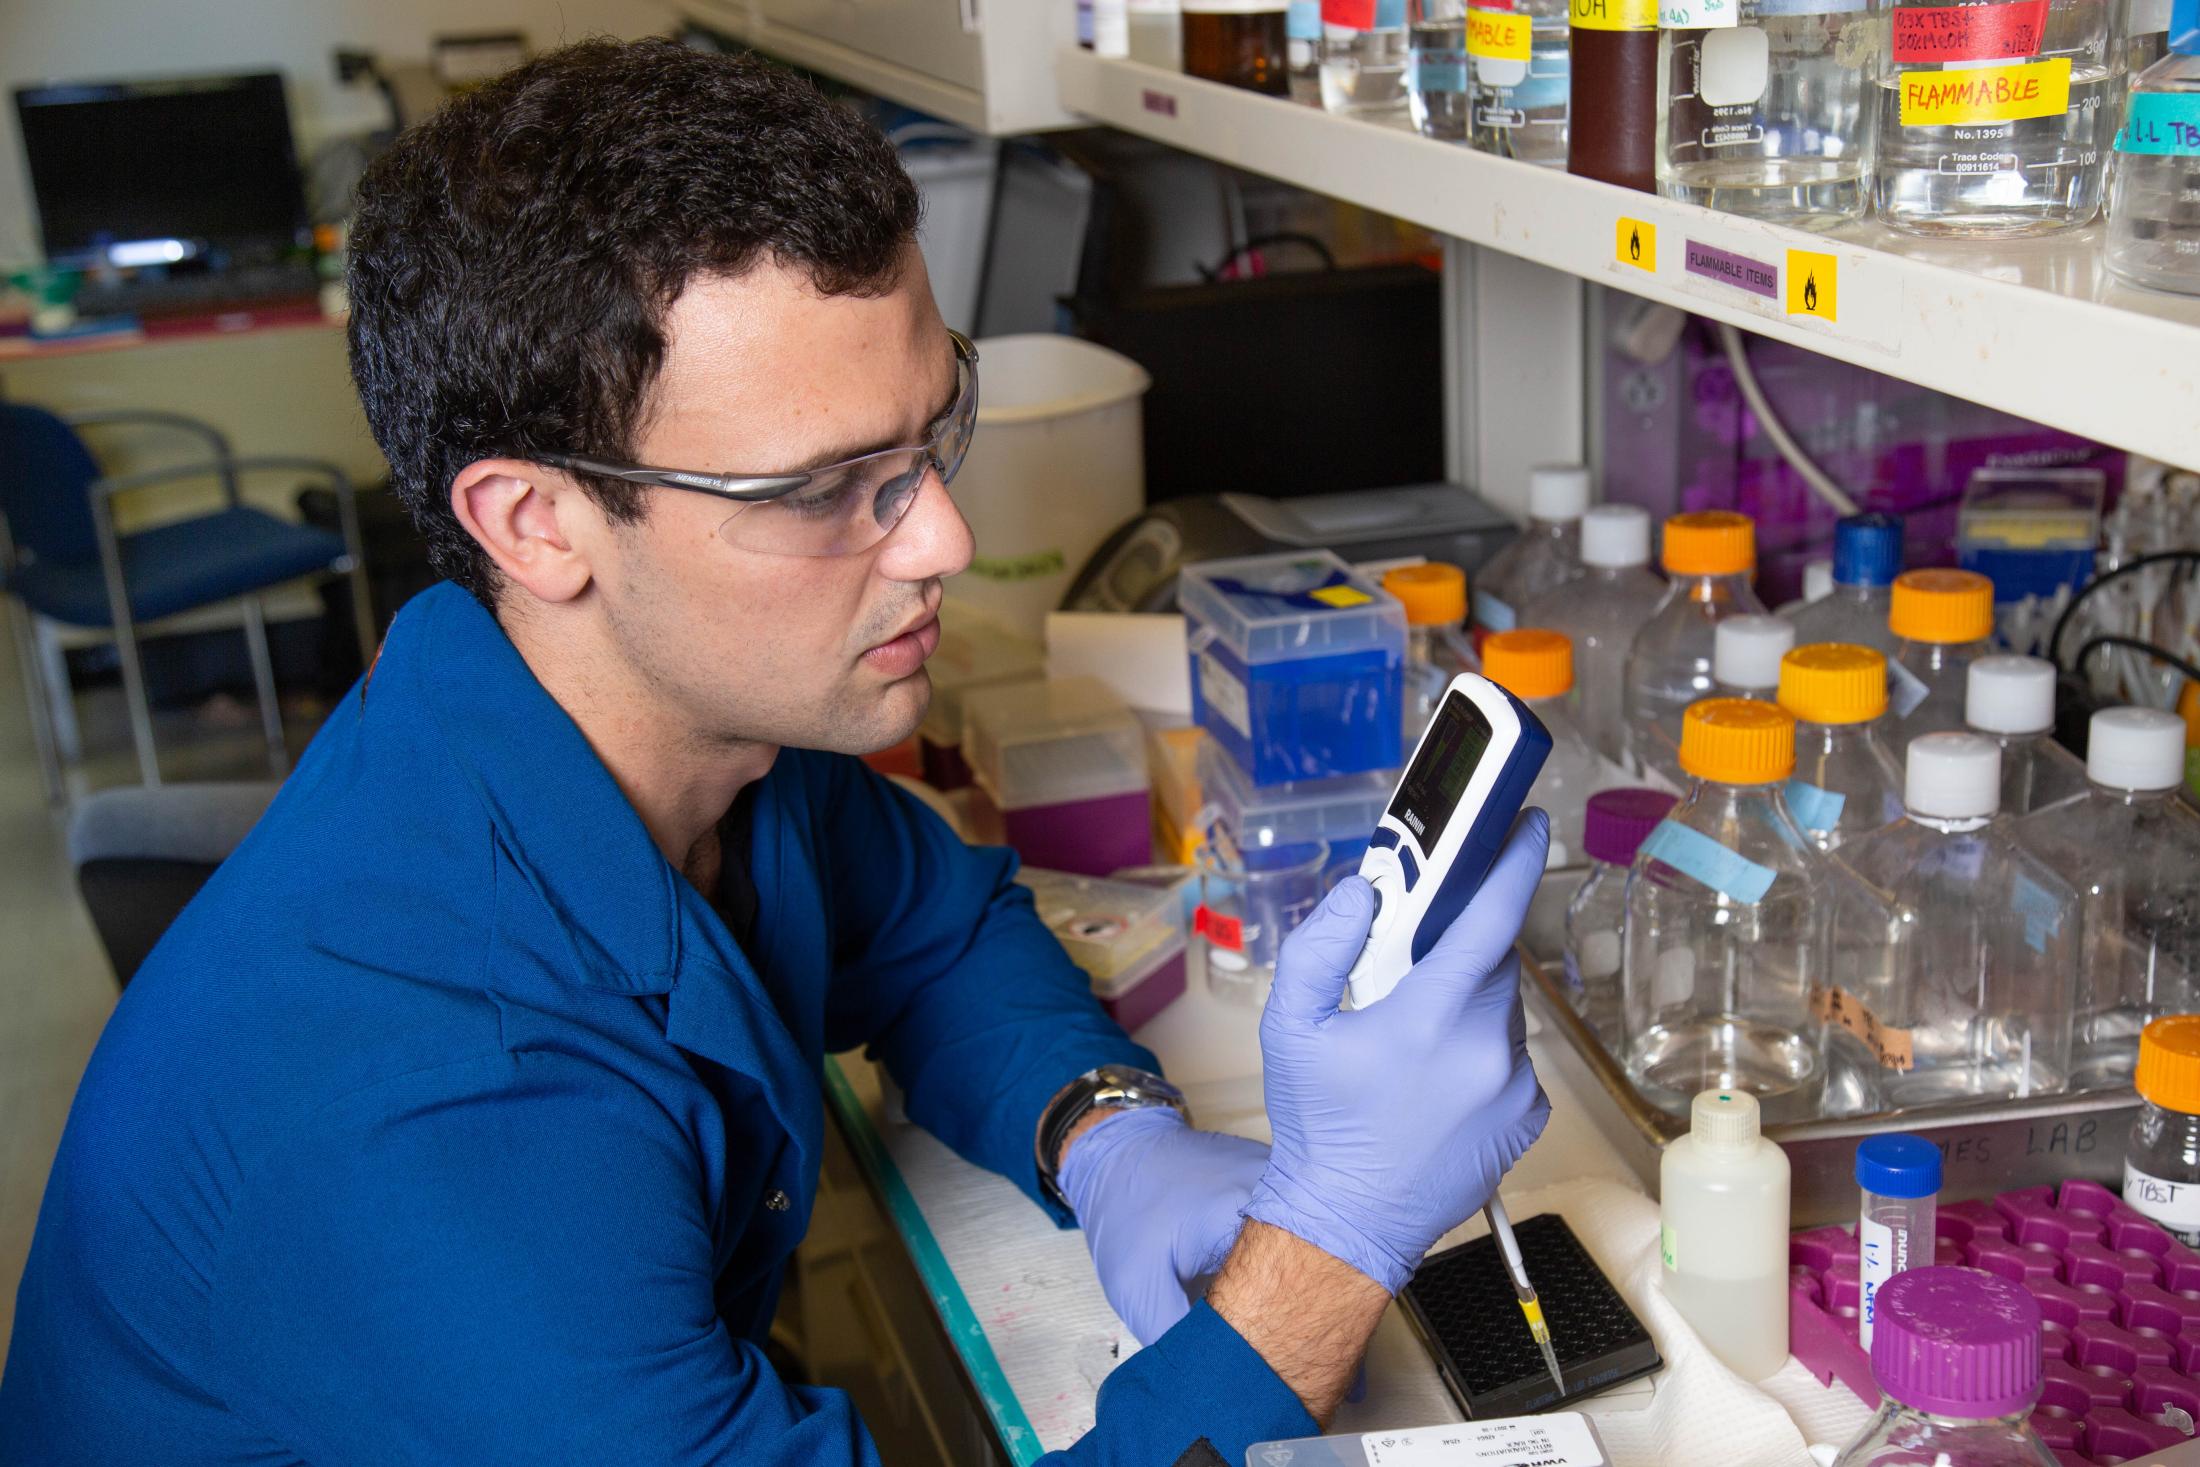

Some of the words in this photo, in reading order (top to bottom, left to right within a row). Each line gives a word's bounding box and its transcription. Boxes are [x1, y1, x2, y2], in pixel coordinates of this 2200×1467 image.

[1908, 77, 2039, 110] FLAMMABLE
[2082, 96, 2100, 111] 200
[1954, 129, 2004, 140] No.1395
[1952, 153, 1978, 161] Trace
[1979, 152, 2005, 161] Code
[2079, 151, 2096, 166] 100
[1690, 252, 1742, 279] FLAMMABLE
[1746, 268, 1774, 289] ITEMS
[675, 474, 713, 485] NEMESIS
[1404, 808, 1426, 836] RAININ
[2026, 1119, 2097, 1156] LAB
[2137, 1178, 2184, 1203] TBST
[1897, 1229, 1908, 1272] nunc
